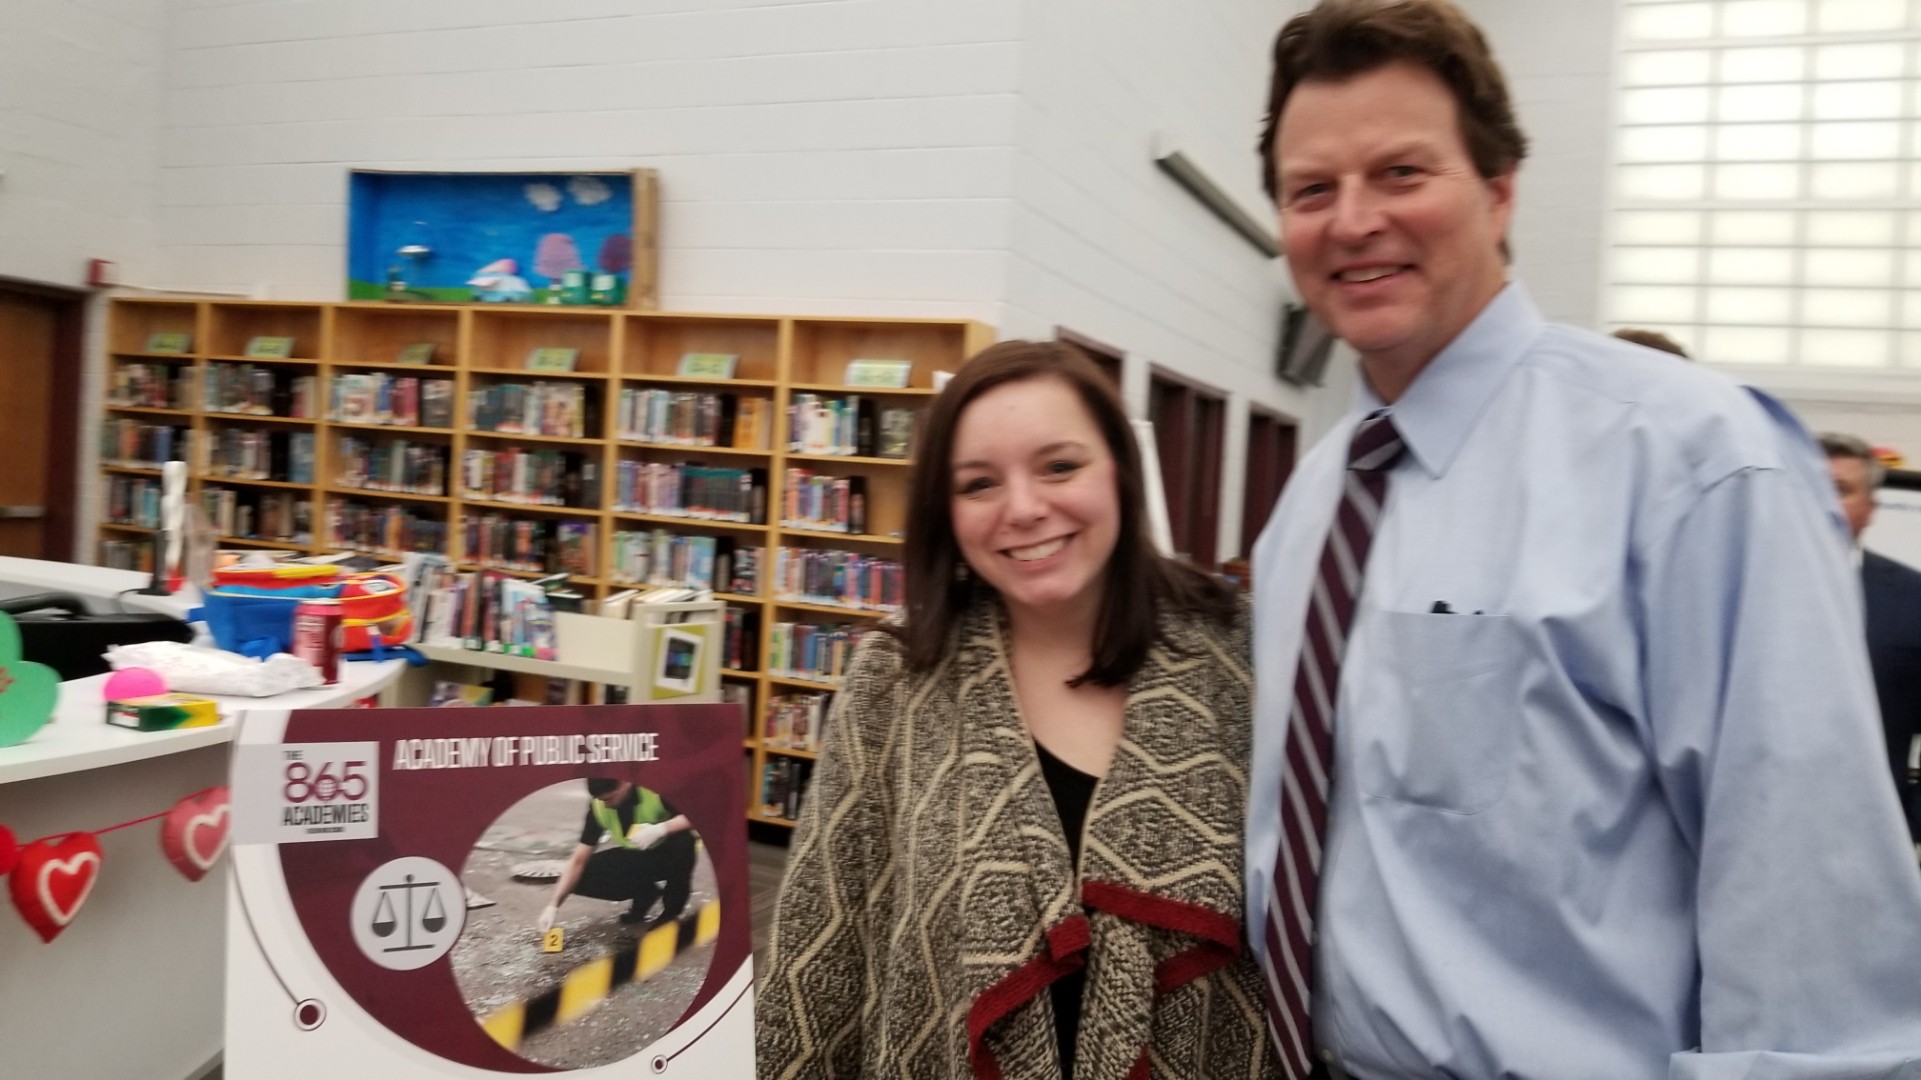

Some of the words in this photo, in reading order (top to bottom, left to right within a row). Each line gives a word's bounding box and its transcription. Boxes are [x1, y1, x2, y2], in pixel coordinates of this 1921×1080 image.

[284, 750, 304, 761] THE
[392, 738, 492, 770] ACADEMY
[491, 736, 519, 767] OF
[519, 734, 585, 766] PUBLIC
[585, 732, 660, 764] SERVICE
[285, 761, 368, 803] 865
[283, 803, 369, 826] ACADEMIES
[549, 934, 559, 947] 2
